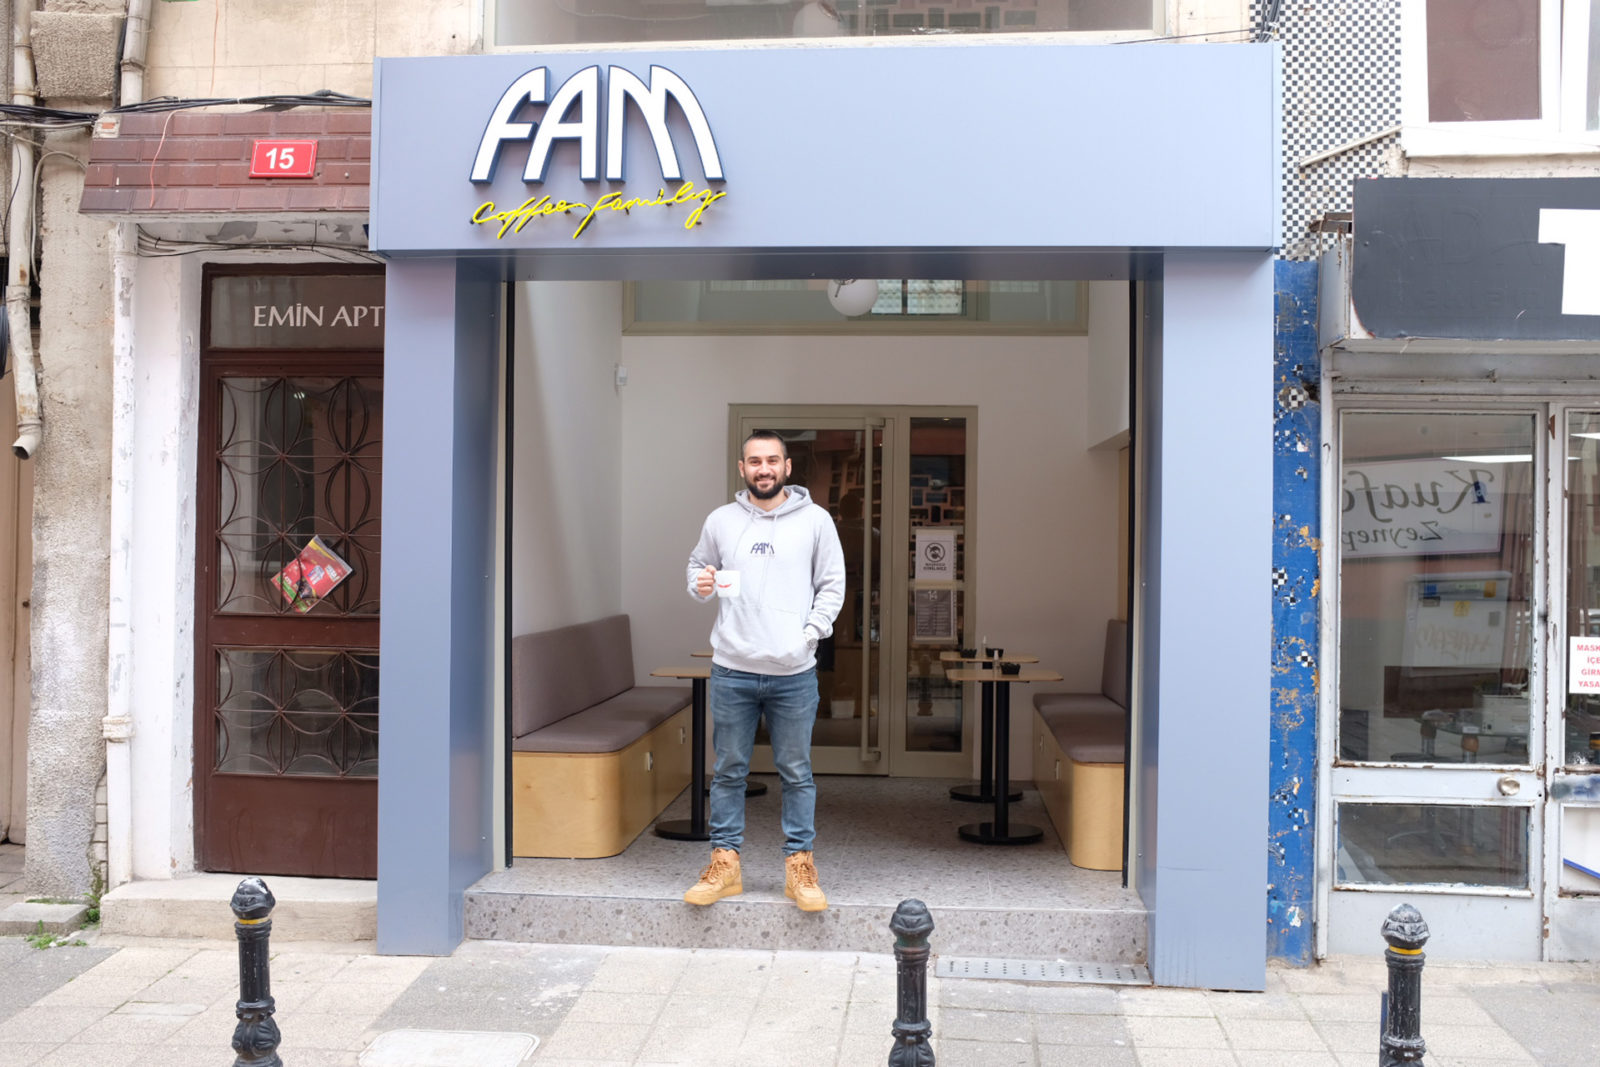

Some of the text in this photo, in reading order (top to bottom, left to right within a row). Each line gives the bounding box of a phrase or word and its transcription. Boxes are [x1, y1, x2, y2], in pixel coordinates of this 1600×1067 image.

[469, 64, 727, 184] FAM
[265, 147, 295, 169] 15
[472, 195, 587, 239] Coffee
[253, 303, 384, 327] EMİN APT
[750, 542, 775, 554] FAM
